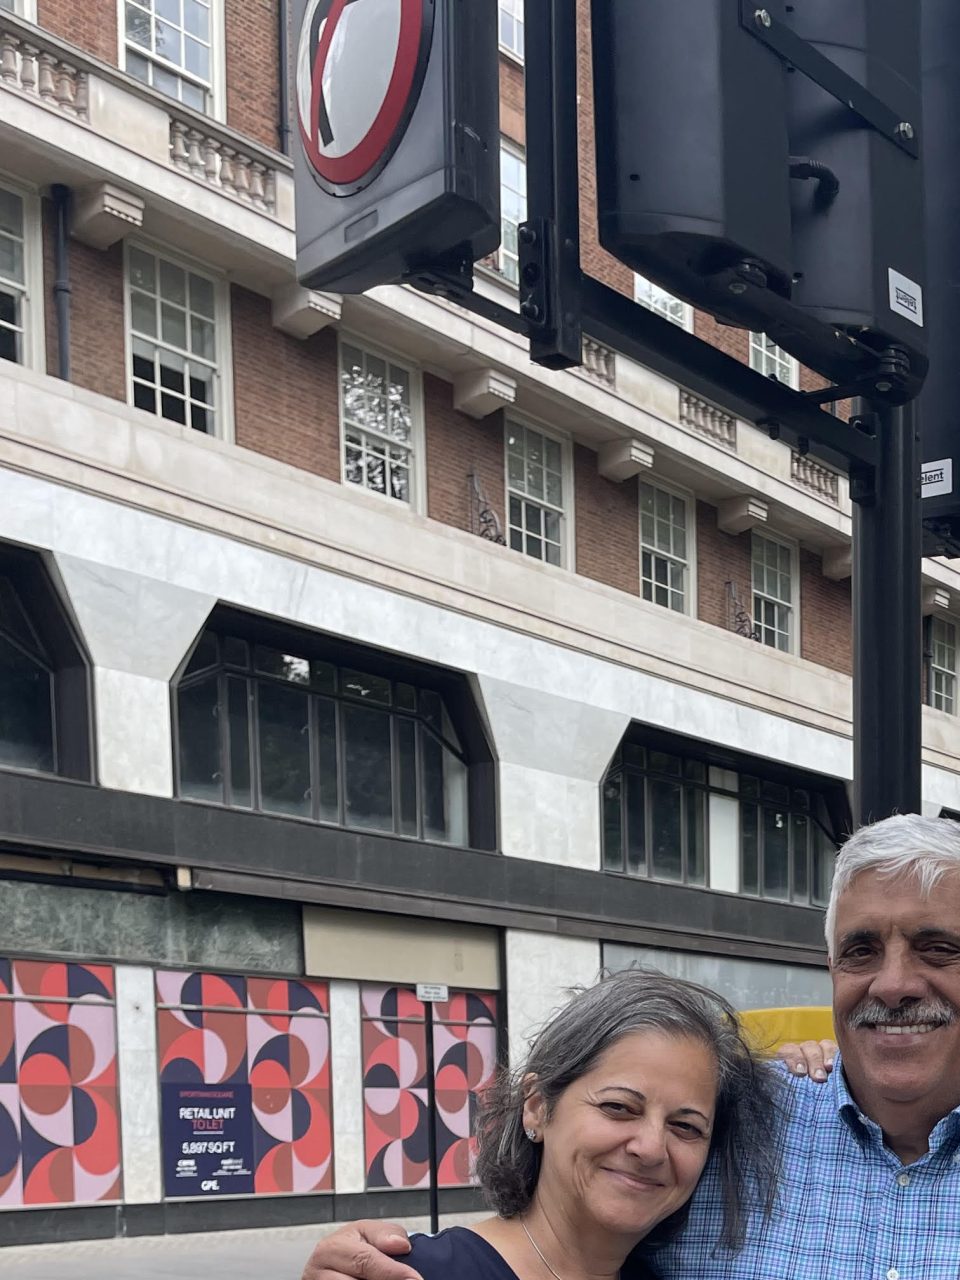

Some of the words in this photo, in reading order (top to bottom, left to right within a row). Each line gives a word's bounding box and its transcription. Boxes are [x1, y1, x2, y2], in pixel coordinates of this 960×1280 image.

[921, 471, 944, 483] elent
[179, 1107, 213, 1120] RETAIL
[213, 1107, 237, 1119] UNIT
[192, 1119, 206, 1130] TO
[206, 1119, 224, 1130] LET
[207, 1141, 222, 1154] SQ
[223, 1141, 235, 1153] FT
